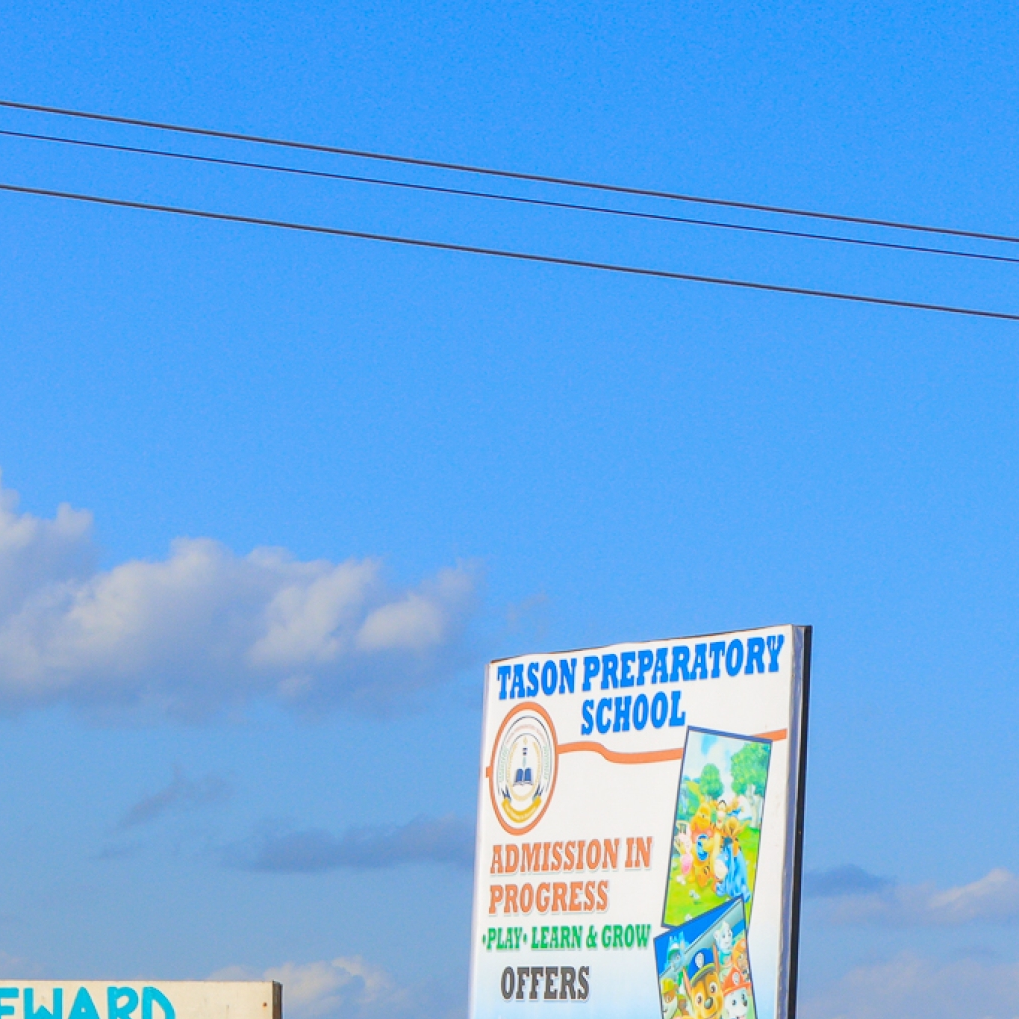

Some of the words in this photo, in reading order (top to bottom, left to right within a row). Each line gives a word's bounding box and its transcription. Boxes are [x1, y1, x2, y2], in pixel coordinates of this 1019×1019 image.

[497, 656, 578, 700] TASON
[581, 634, 785, 691] PREPARATORY
[581, 690, 686, 735] SCHOOL
[490, 838, 620, 875] ADMISSION
[624, 836, 653, 868] IN
[488, 880, 609, 915] PROGRESS
[531, 925, 583, 949] LEARN
[586, 924, 598, 948] &
[601, 923, 651, 949] GROW
[500, 965, 590, 1000] OFFERS
